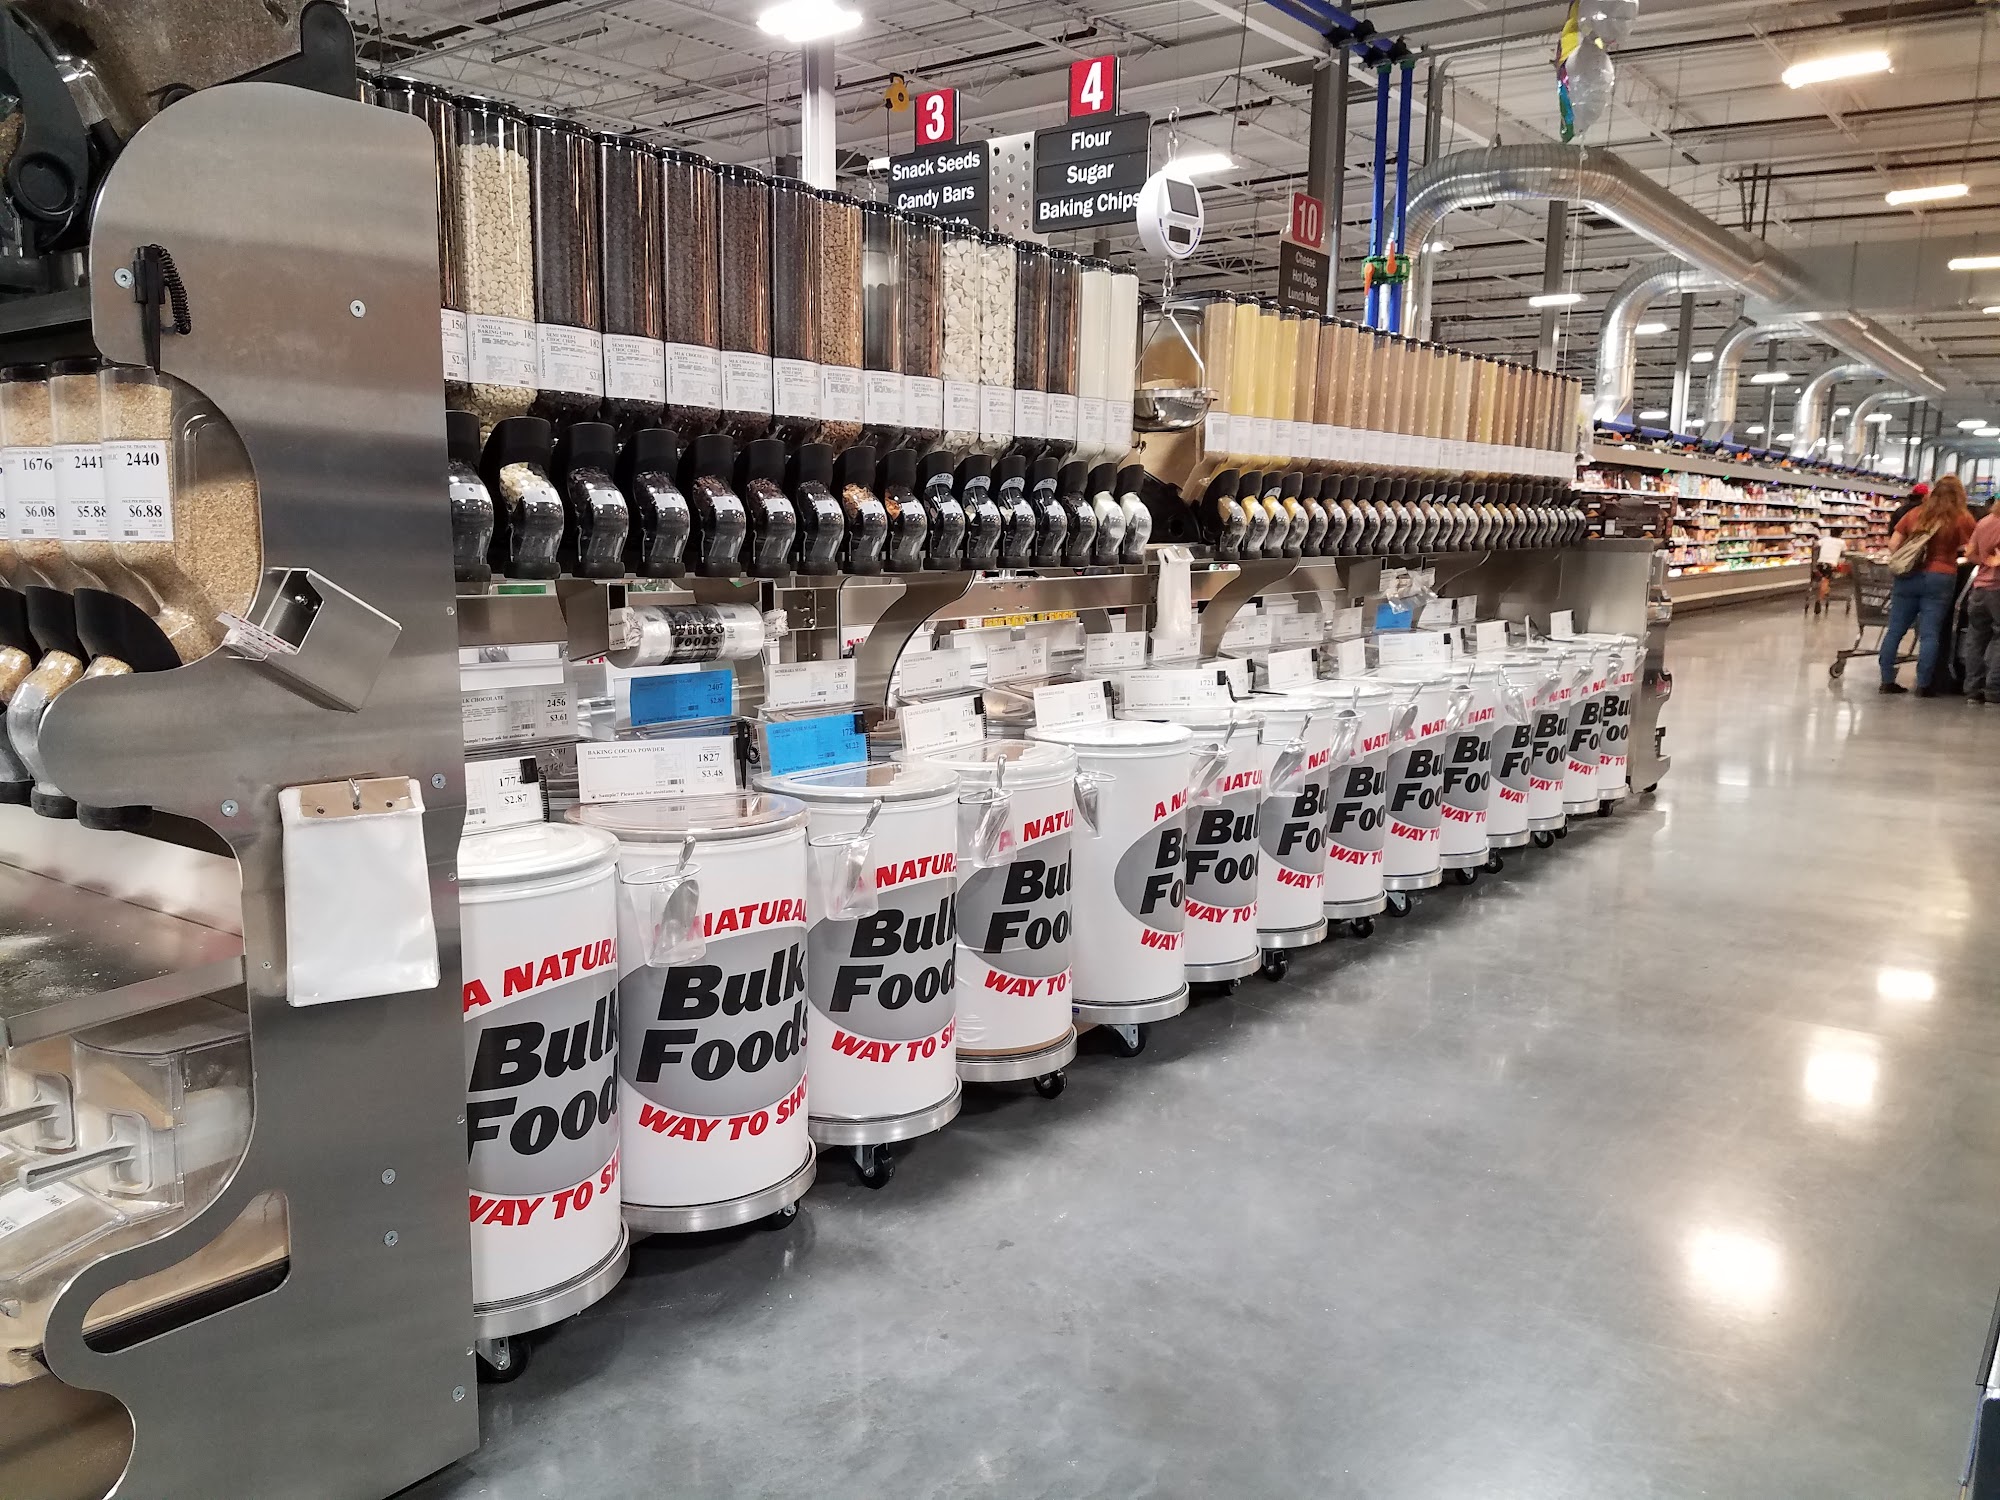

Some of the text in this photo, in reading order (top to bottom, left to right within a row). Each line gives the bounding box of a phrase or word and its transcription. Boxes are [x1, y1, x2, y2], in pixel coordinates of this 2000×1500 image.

[1081, 62, 1103, 110] 4
[926, 95, 945, 140] 3
[1071, 130, 1112, 151] Flour
[892, 151, 980, 181] Snack Seeds
[1066, 163, 1114, 184] Sugar
[898, 185, 975, 210] Candy Bars
[1040, 191, 1140, 220] Baking Chips
[1299, 200, 1317, 241] 10
[1295, 251, 1316, 268] Cheese
[1292, 269, 1318, 289] Hot Dogs
[1288, 286, 1320, 306] Lunch Meat
[23, 458, 53, 471] 1676
[74, 455, 103, 469] 2441
[126, 452, 160, 466] 2440
[25, 505, 56, 518] $6.08
[77, 505, 107, 518] $5.88
[129, 505, 163, 518] $6.88
[708, 683, 723, 691] 2407
[471, 695, 504, 703] CHOCOLATE
[547, 698, 566, 708] 2456
[550, 713, 568, 722] $3.61
[698, 753, 720, 762] 1827
[1568, 760, 1593, 776] WAY
[701, 769, 724, 778] $3.48
[1443, 767, 1490, 794] Foo
[504, 794, 528, 805] $2.87
[1500, 788, 1526, 803] WAY
[1153, 801, 1167, 822] A
[1329, 802, 1385, 833] Foo
[1441, 804, 1473, 823] WAY
[1391, 822, 1428, 841] WAY
[1330, 845, 1369, 865] WAY
[1277, 868, 1315, 889] WAY
[1185, 898, 1229, 923] WAY
[1233, 906, 1250, 923] TO
[1140, 929, 1179, 951] WAY
[657, 942, 806, 1021] Bulk
[984, 970, 1046, 997] WAY
[1047, 972, 1066, 996] TO
[463, 979, 492, 1013] A
[468, 986, 618, 1093] Bulk
[635, 999, 808, 1083] Foods
[830, 1030, 901, 1063] WAY
[907, 1036, 936, 1062] TO
[467, 1053, 618, 1166] Food
[638, 1103, 721, 1142] WAY
[728, 1111, 769, 1141] TO
[552, 1181, 593, 1220] TO
